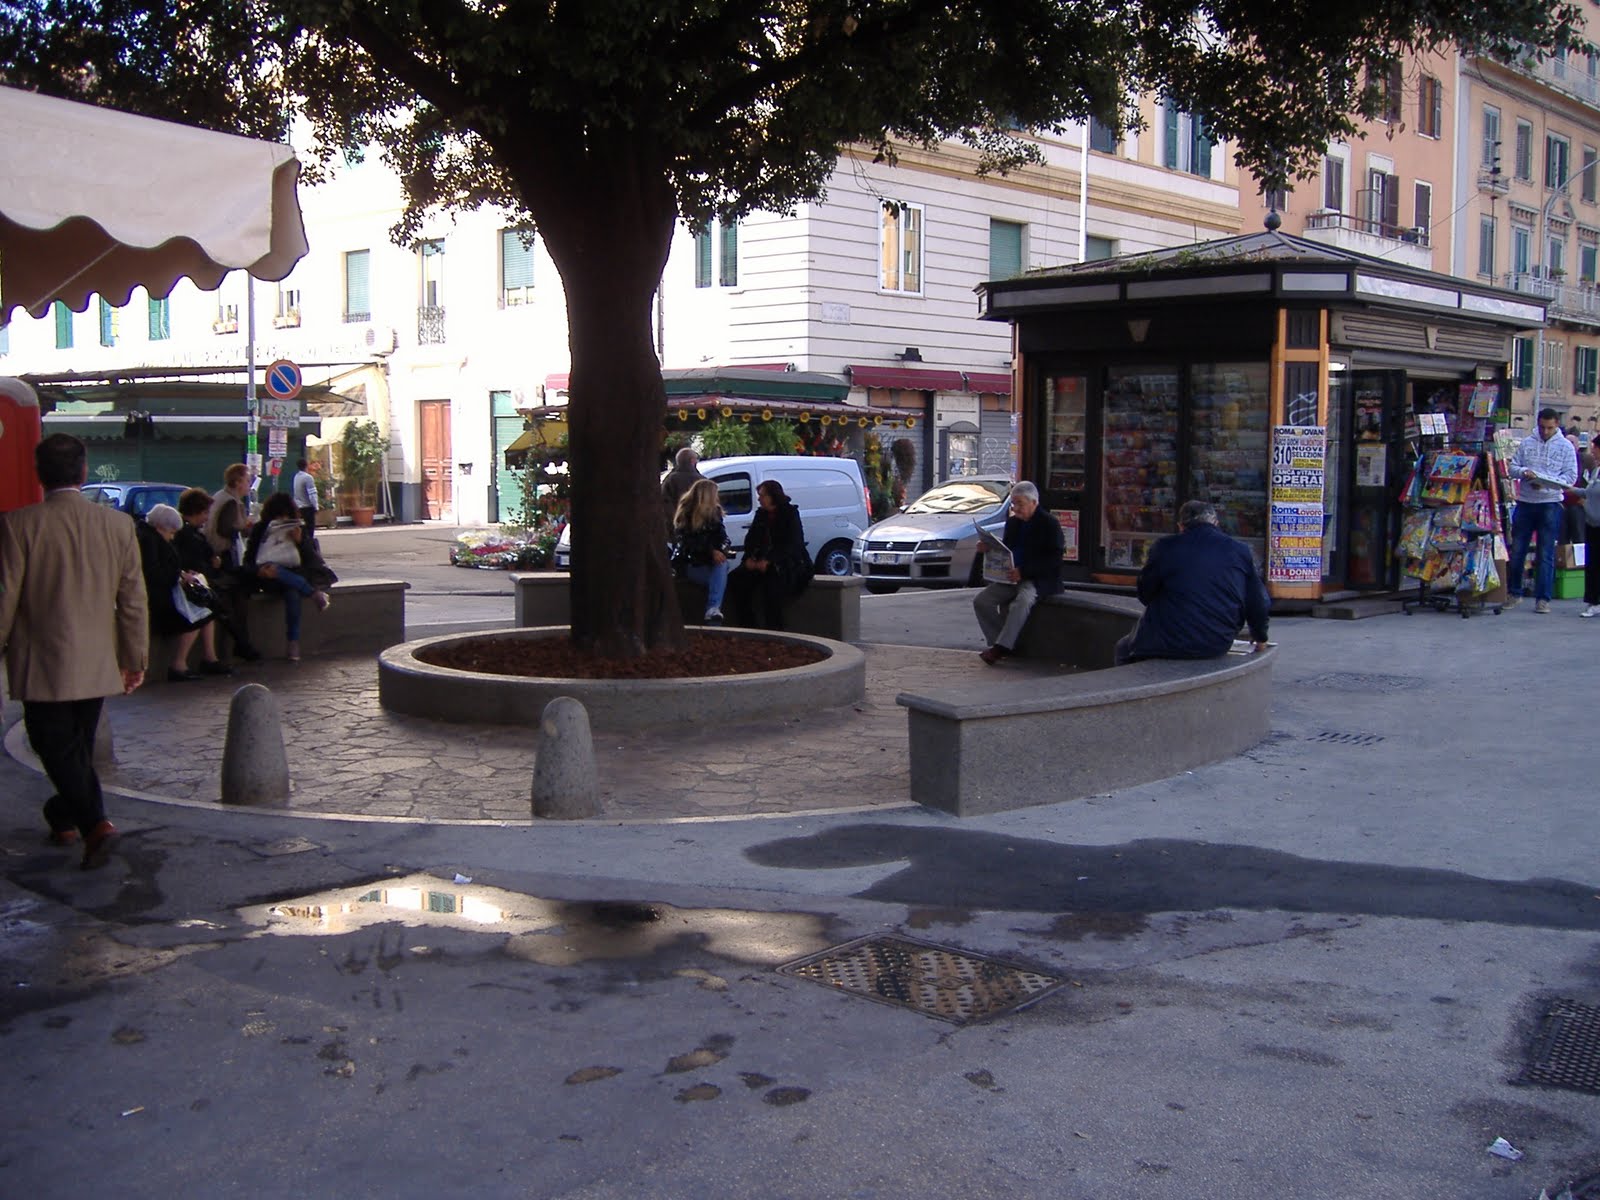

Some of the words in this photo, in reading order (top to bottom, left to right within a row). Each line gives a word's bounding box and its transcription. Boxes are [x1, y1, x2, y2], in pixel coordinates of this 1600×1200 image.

[1274, 427, 1295, 436] ROMA
[1273, 446, 1292, 465] 310
[1273, 475, 1323, 484] OPERAI
[1272, 505, 1297, 514] Roma
